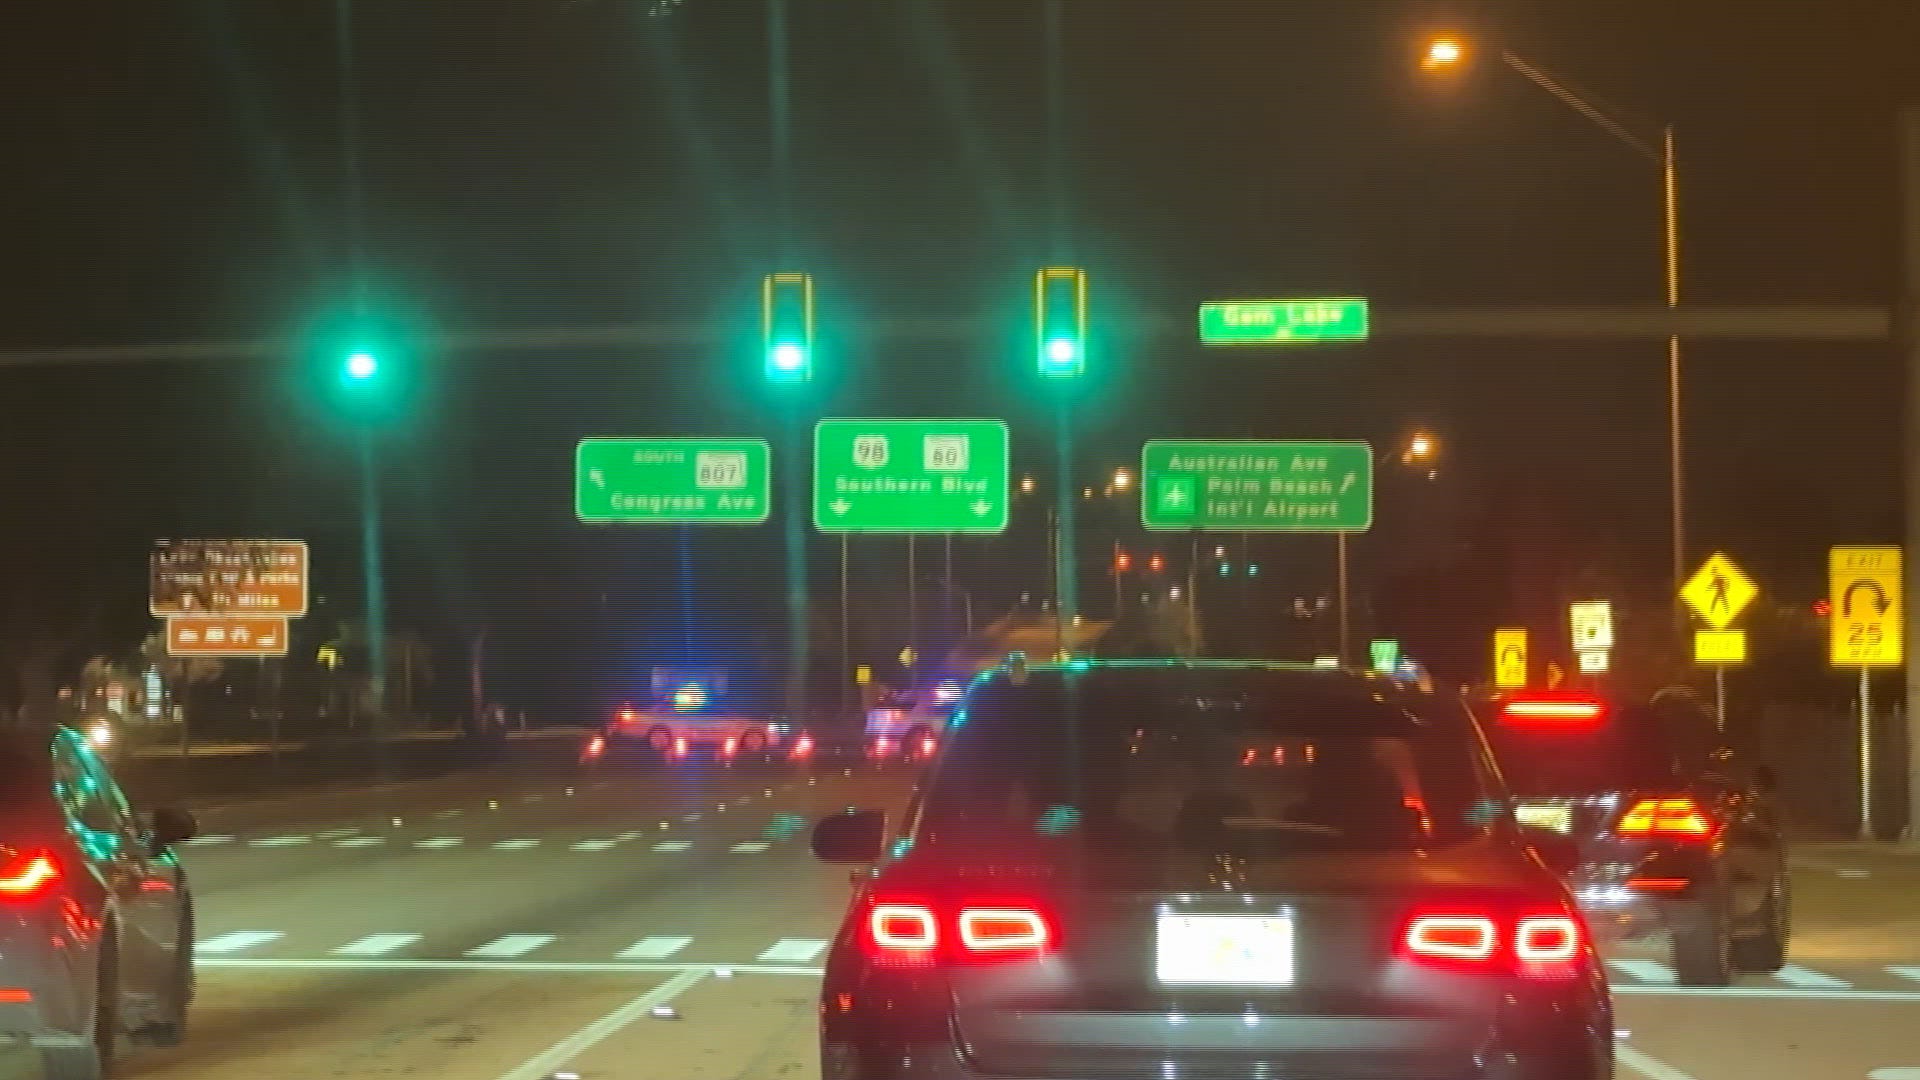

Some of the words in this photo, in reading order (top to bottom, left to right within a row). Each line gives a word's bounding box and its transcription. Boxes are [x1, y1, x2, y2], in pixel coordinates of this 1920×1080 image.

[858, 440, 884, 462] 98
[1168, 453, 1280, 471] Australian
[1290, 454, 1328, 471] Ave
[700, 464, 737, 484] 807
[835, 475, 932, 494] Southern
[941, 475, 988, 494] Blvd
[1207, 477, 1260, 494] Palm
[1270, 477, 1333, 495] Beach
[611, 492, 706, 514] Congress
[717, 493, 756, 510] Ave
[1207, 499, 1252, 518] Int'l
[1264, 500, 1339, 521] Airport
[1847, 622, 1883, 646] 25
